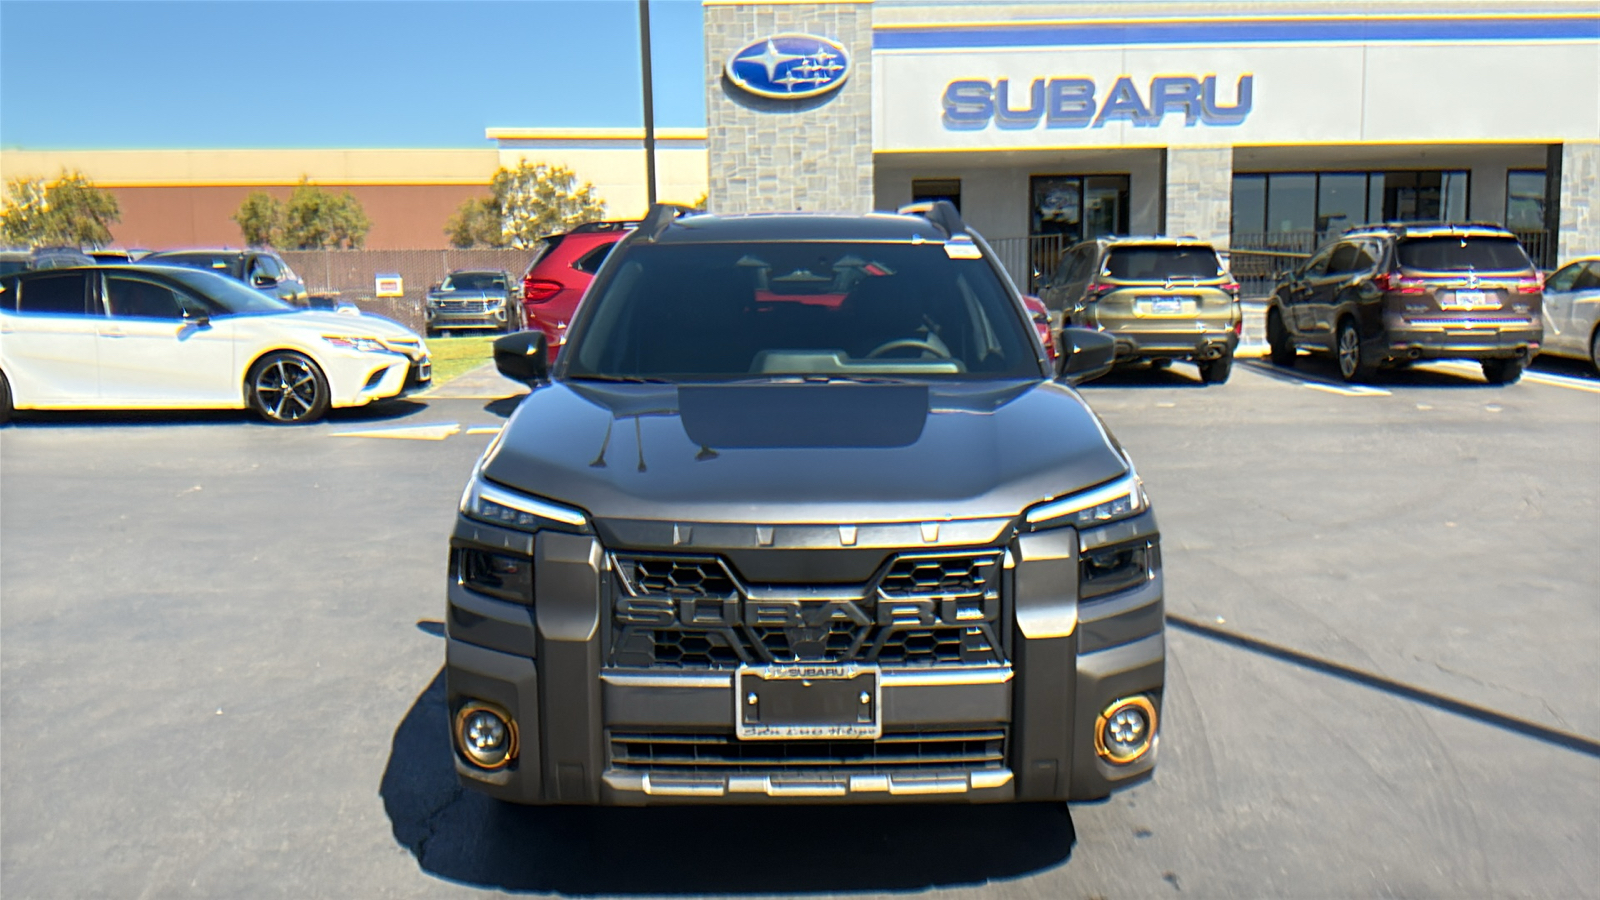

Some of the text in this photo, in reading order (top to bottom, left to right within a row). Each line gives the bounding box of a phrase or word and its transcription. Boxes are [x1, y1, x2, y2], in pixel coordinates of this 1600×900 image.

[943, 74, 1253, 125] SUBARU
[616, 597, 999, 627] SUBARU
[788, 666, 845, 678] SUBARU
